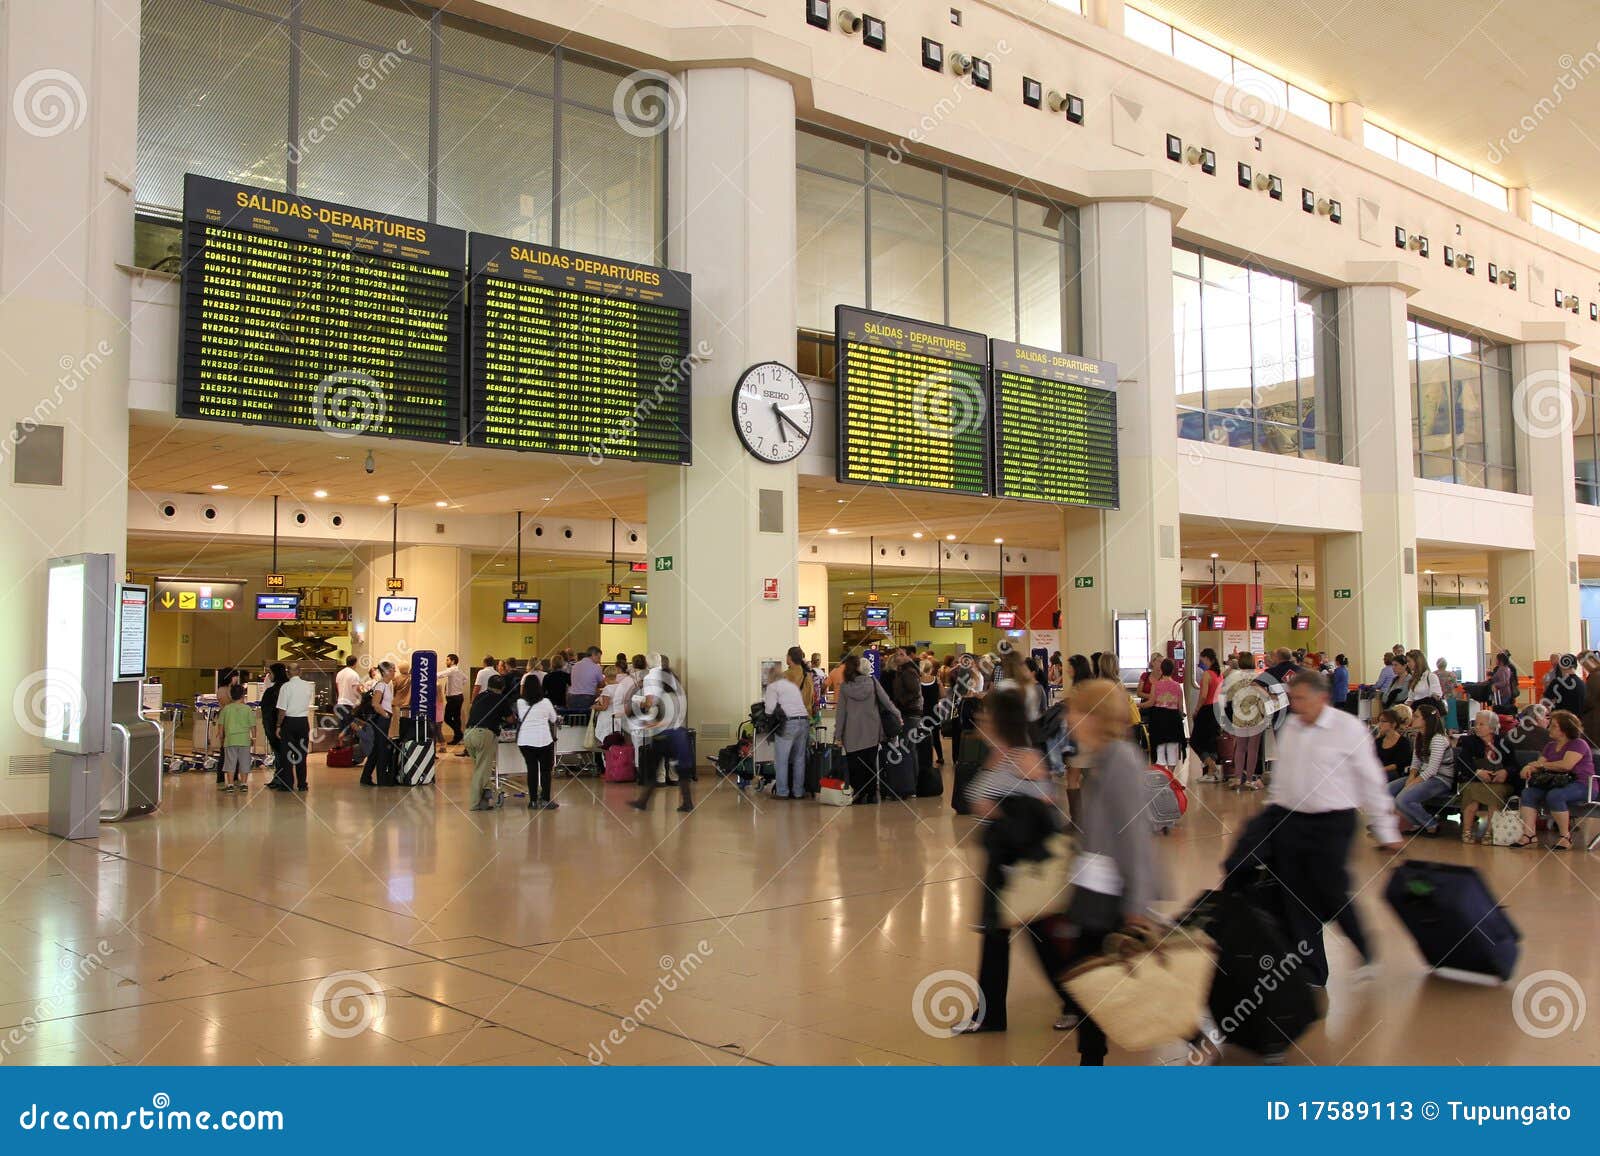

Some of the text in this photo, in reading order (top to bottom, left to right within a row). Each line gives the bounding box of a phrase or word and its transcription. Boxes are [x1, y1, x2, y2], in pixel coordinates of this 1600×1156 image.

[236, 192, 426, 243] SALIDAS-DEPARTURES
[246, 245, 293, 262] FRANKFURT
[297, 243, 322, 255] 17:30
[246, 257, 292, 273] FRANKFURT
[510, 247, 660, 286] SALIDAS-DEPARTURES
[245, 269, 292, 285] FRANKFURT
[296, 289, 321, 301] 17:40
[244, 304, 281, 318] TREVISO
[244, 327, 275, 340] DUBLIN
[864, 322, 903, 339] SALIDAS
[910, 331, 967, 352] DEPARTURES
[243, 339, 290, 354] BARCELONA
[243, 351, 264, 362] PISA
[1015, 348, 1047, 364] SALIDAS
[1052, 357, 1098, 374] DEPARTURES
[757, 372, 765, 385] 11
[771, 368, 782, 382] 12
[242, 386, 279, 399] MELILLA
[746, 384, 757, 395] 10
[763, 390, 790, 401] SEIKO
[798, 392, 805, 404] 2
[740, 402, 748, 415] 9
[241, 411, 263, 420] ROMA
[803, 412, 809, 423] 3
[745, 420, 752, 434] 8
[757, 437, 764, 449] 7
[788, 441, 794, 453] 5
[772, 444, 778, 456] 6
[268, 576, 282, 584] 245
